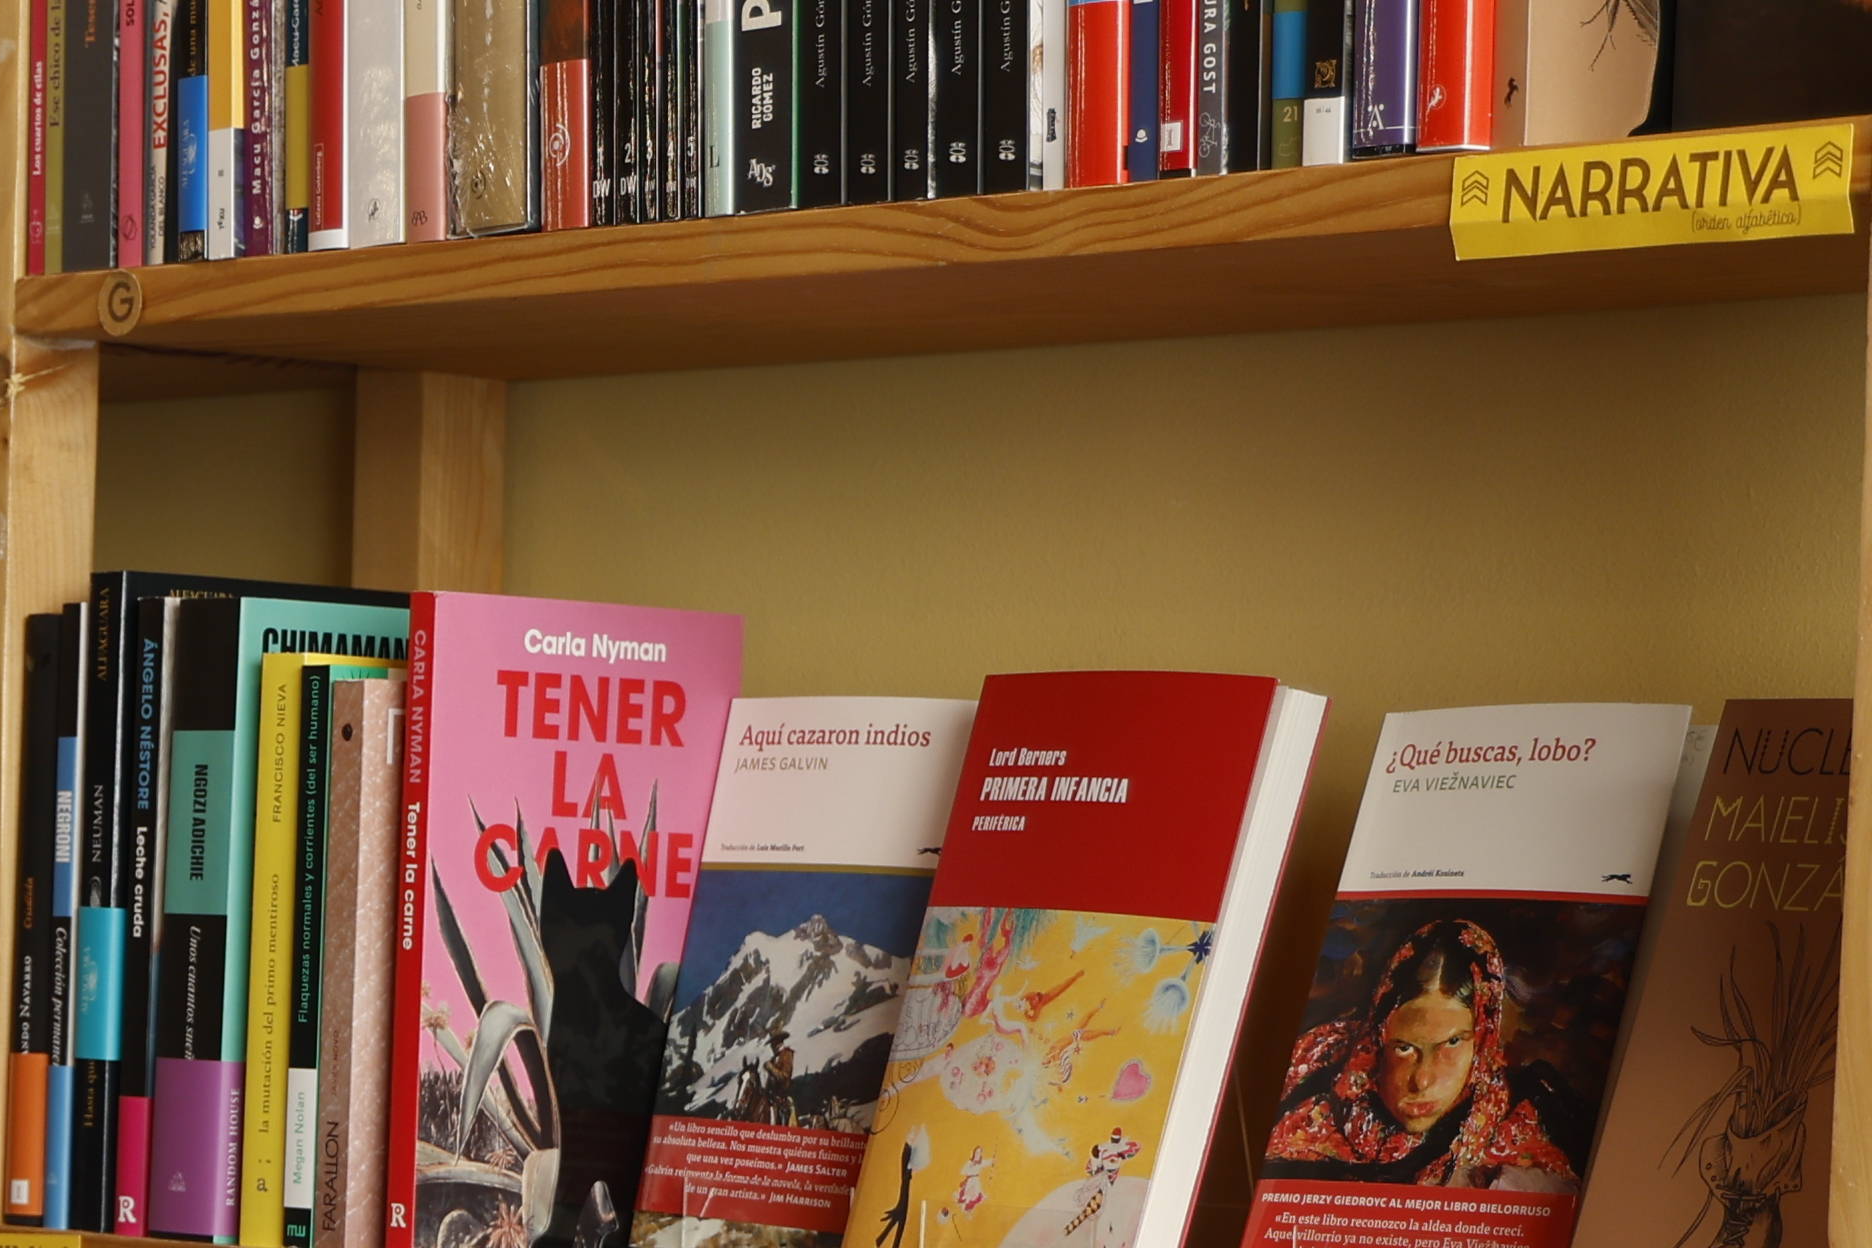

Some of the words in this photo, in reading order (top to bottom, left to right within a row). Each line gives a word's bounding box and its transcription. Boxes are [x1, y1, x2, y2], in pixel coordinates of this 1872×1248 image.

[152, 11, 170, 150] EXCLUSAS,
[1202, 43, 1217, 94] GOST
[751, 67, 762, 130] RICARDO
[1282, 106, 1298, 122] 21
[1502, 144, 1800, 224] NARRATIVA
[108, 280, 135, 310] G
[95, 587, 110, 681] ALFAGUARA
[524, 629, 587, 658] Carla
[592, 633, 668, 664] Nyman
[412, 629, 427, 701] CARLA
[275, 683, 287, 727] NIEVA
[307, 674, 321, 740] humano)
[496, 669, 687, 748] TENER
[308, 743, 318, 765] ser
[409, 705, 426, 784] NYMAN
[739, 723, 785, 752] Aquí
[787, 726, 860, 747] cazaron
[864, 723, 931, 747] indios
[989, 748, 1015, 767] Lord
[1017, 748, 1067, 767] Berners
[1385, 740, 1442, 775] ¿Qué
[1445, 738, 1524, 769] buscas,
[1528, 737, 1597, 763] lobo?
[137, 725, 155, 810] NÉSTORE
[192, 763, 208, 813] NGOZI
[271, 732, 286, 824] FRANCISCO
[304, 768, 318, 795] (del
[551, 750, 628, 821] LA
[734, 757, 777, 774] JAMES
[778, 756, 829, 771] GALVIN
[979, 776, 1048, 802] PRIMERA
[1050, 776, 1130, 804] INFANCIA
[1392, 776, 1421, 794] EVA
[1425, 771, 1517, 792] VIEŽNAVIEC
[55, 790, 73, 863] NEGRONI
[91, 784, 104, 862] NEUMAN
[189, 817, 207, 880] ADICHIE
[304, 799, 317, 869] corrientes
[404, 801, 421, 852] Tener
[971, 813, 1026, 832] PERIFÉRICA
[133, 826, 148, 879] Leche
[404, 855, 416, 884] la
[474, 823, 694, 899] CARNE
[131, 884, 144, 938] cruda
[268, 874, 280, 954] mentiroso
[300, 884, 313, 950] normales
[400, 888, 415, 952] carne
[264, 958, 277, 1006] primo
[298, 953, 312, 1023] Flaquezas
[262, 1011, 274, 1035] del
[260, 1040, 273, 1114] mutación
[228, 1087, 241, 1136] HOUSE
[295, 1091, 306, 1135] Nolan
[225, 1141, 239, 1207] RANDOM
[292, 1139, 305, 1185] Megan
[1262, 1193, 1302, 1204] PREMIO
[1301, 1195, 1334, 1206] JERZY
[1334, 1195, 1388, 1208] GIEDROYC
[1388, 1198, 1403, 1208] AL
[1405, 1199, 1441, 1211] MEJOR
[1444, 1201, 1478, 1213] LIBRO
[1479, 1203, 1552, 1217] BIELORRUSO
[1298, 1215, 1321, 1225] este
[1322, 1213, 1349, 1227] libro
[1350, 1218, 1408, 1230] reconozco
[1409, 1218, 1420, 1231] la
[1422, 1219, 1453, 1233] aldea
[1454, 1221, 1491, 1235] donde
[1493, 1224, 1525, 1237] crecí.
